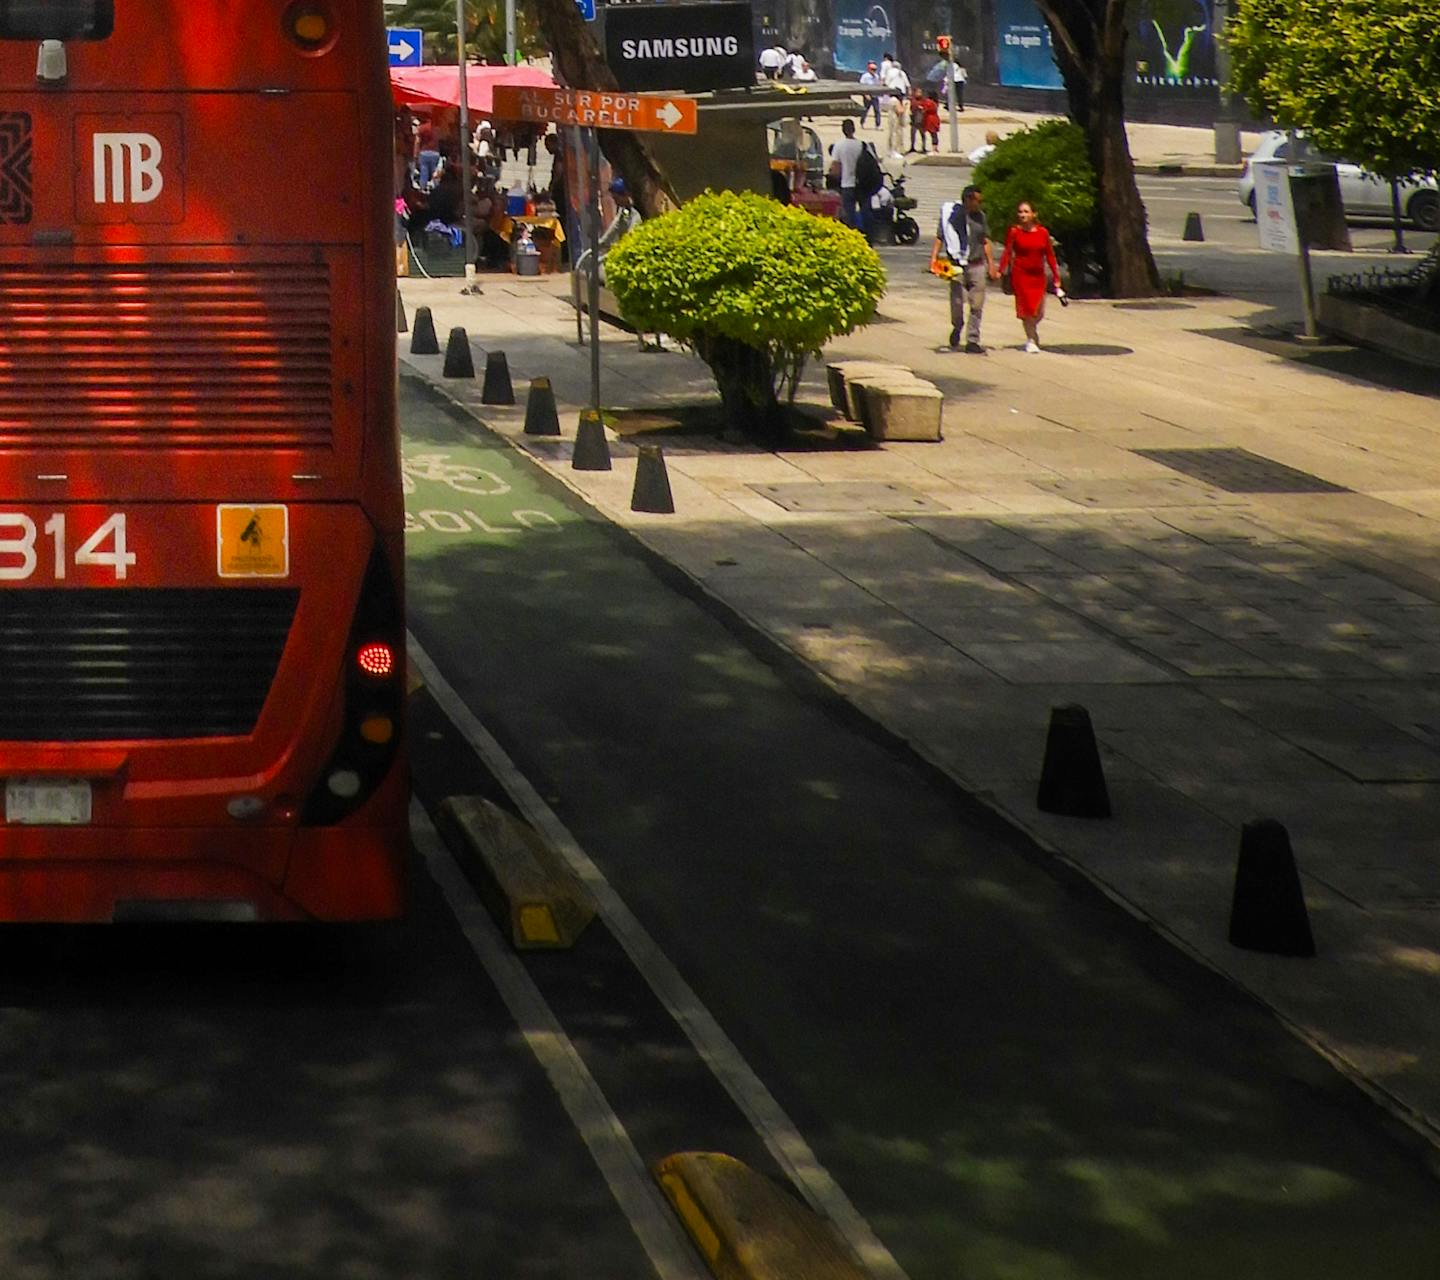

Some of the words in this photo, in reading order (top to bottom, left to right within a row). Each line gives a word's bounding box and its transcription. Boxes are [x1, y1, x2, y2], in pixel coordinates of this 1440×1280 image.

[622, 36, 738, 59] SAMSUNG
[600, 96, 641, 111] POR
[521, 104, 633, 126] BUCARELI
